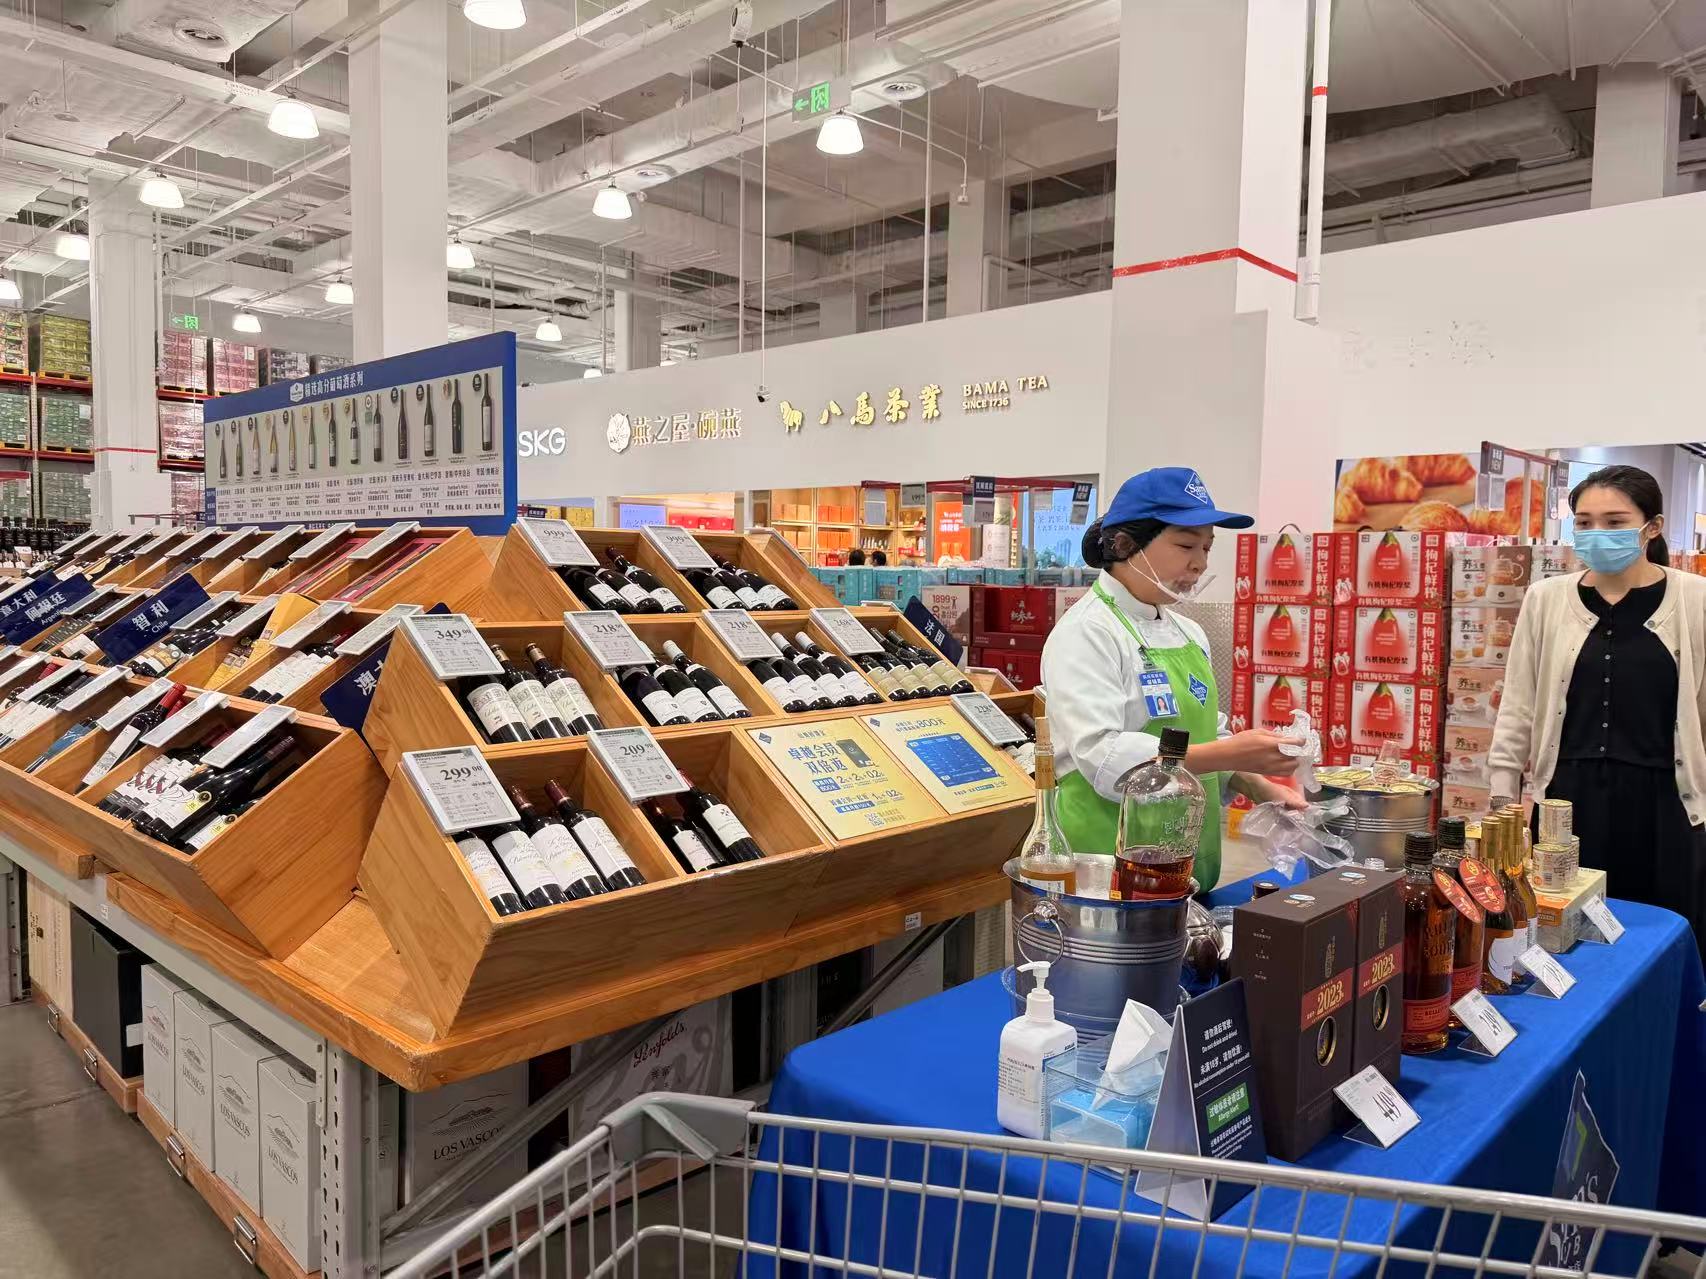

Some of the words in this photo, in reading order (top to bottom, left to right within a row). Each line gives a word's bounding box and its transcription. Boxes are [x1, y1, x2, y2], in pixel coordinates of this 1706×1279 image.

[962, 379, 1009, 397] BAMA
[1016, 375, 1049, 392] TEA
[818, 383, 942, 426] 八馬茶業
[962, 398, 987, 410] SINCE
[988, 396, 1009, 408] 1736
[518, 427, 567, 457] SKG
[131, 599, 170, 630] 智利
[151, 618, 169, 634] Chile
[434, 629, 462, 640] 349
[593, 623, 616, 634] 218
[728, 620, 746, 630] 218
[924, 619, 946, 647] 法国
[620, 744, 645, 756] 209
[788, 742, 841, 761] 卓越会员
[440, 766, 472, 780] 299
[803, 757, 848, 775] 双倍返
[1371, 953, 1394, 985] 2023
[1317, 980, 1343, 1015] 2023
[1372, 1090, 1402, 1122] 449
[220, 1103, 231, 1119] LOS
[229, 1109, 251, 1137] VASCOS
[433, 1142, 458, 1161] LOS
[267, 1145, 279, 1163] LOS
[277, 1154, 299, 1184] VASCOS
